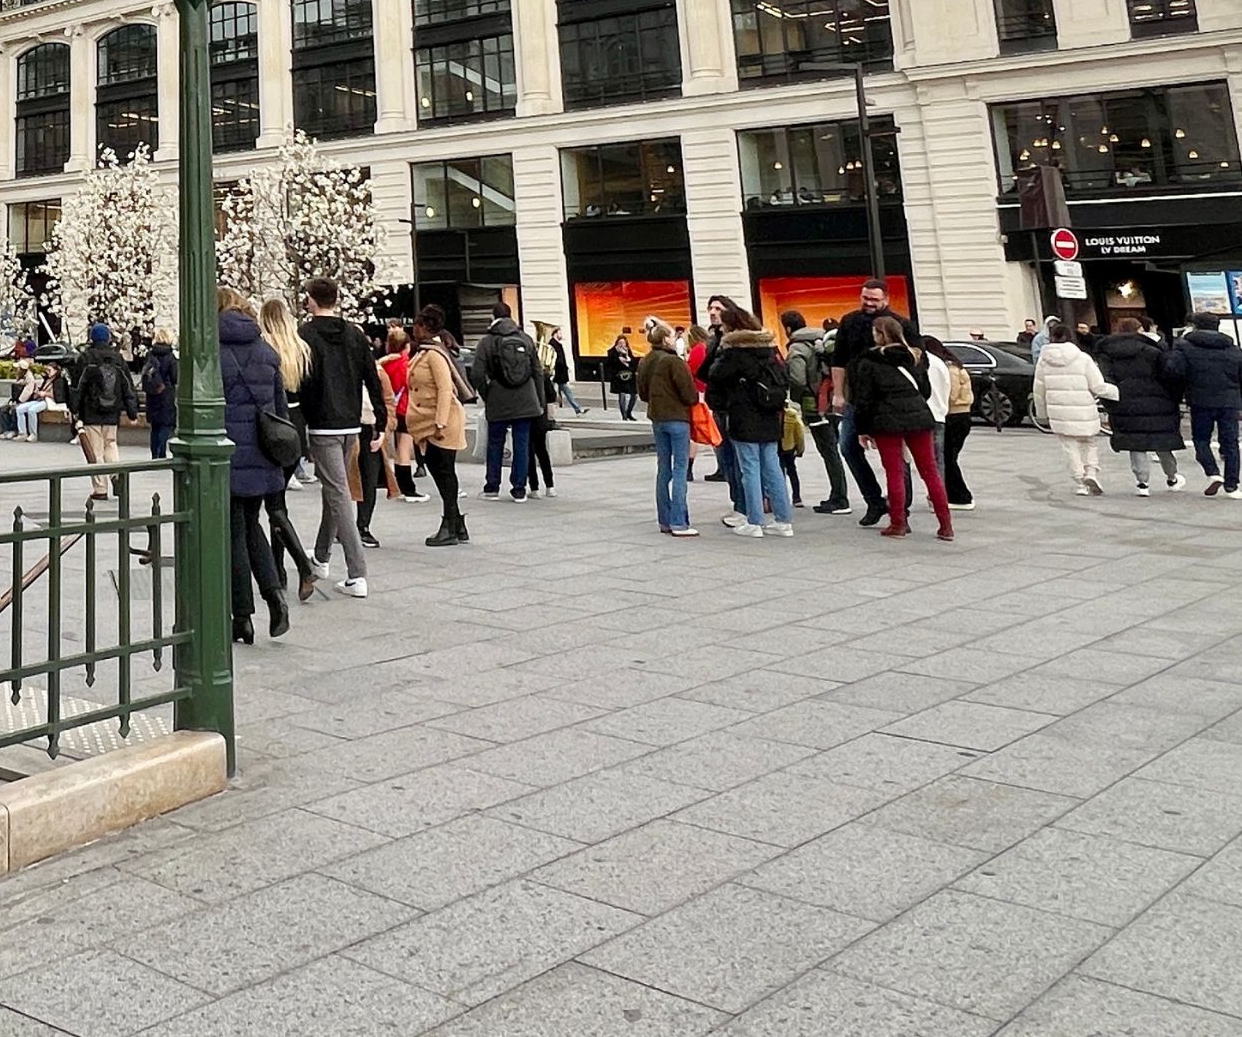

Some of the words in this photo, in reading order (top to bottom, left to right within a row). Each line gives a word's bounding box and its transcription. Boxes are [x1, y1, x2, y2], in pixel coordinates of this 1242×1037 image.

[1085, 237, 1115, 246] LOUIS
[1116, 235, 1160, 245] VUITTON
[1101, 246, 1111, 254] LV
[1113, 245, 1146, 253] DREAM
